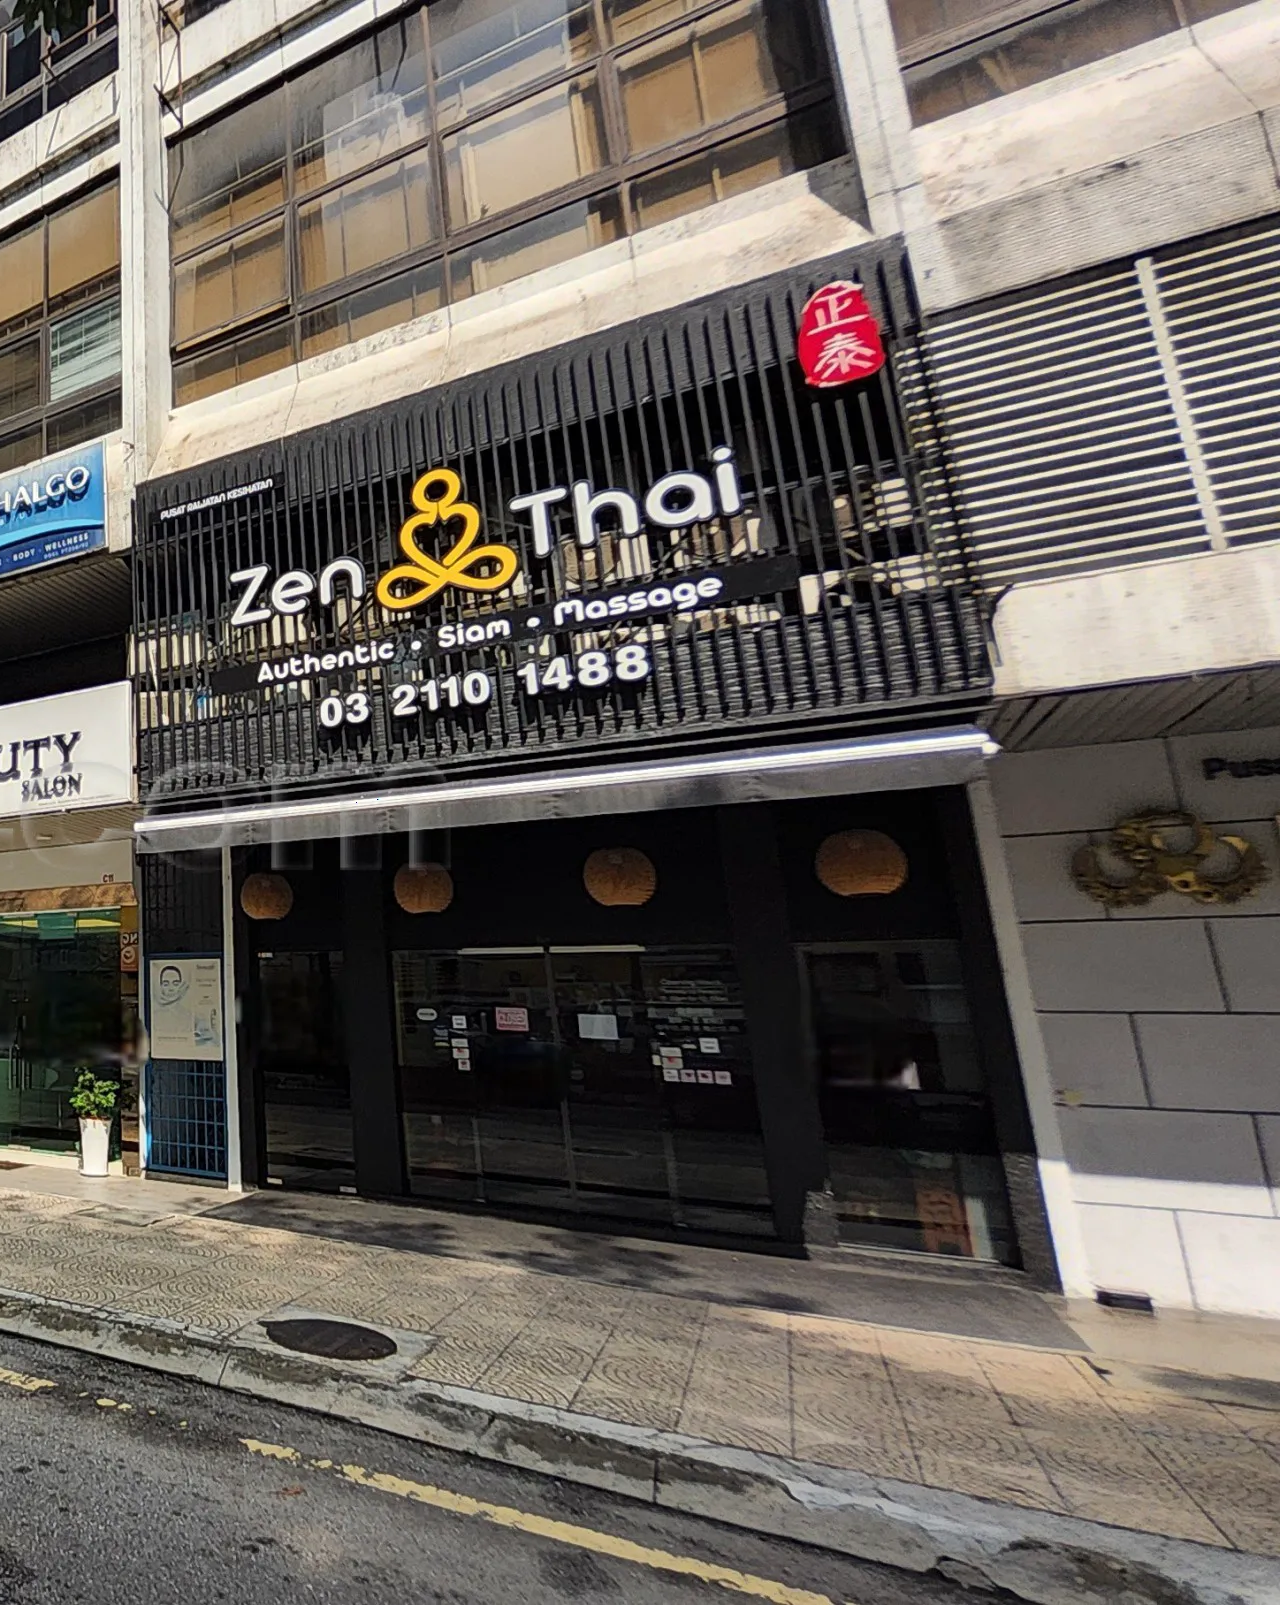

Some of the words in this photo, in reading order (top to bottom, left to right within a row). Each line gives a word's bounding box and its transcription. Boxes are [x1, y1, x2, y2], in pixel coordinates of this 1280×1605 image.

[806, 287, 877, 379] 正泰
[161, 504, 185, 520] PUSAT
[227, 478, 273, 500] KESIHATAN
[230, 557, 365, 626] Zen
[509, 446, 742, 557] Thai
[44, 532, 90, 552] WELLNESS
[257, 640, 395, 684] Authentic
[437, 618, 511, 648] Siam
[553, 576, 723, 626] Massage
[320, 692, 370, 728] 03
[392, 671, 492, 716] 2110
[517, 644, 650, 695] 1488
[21, 773, 82, 802] SALON
